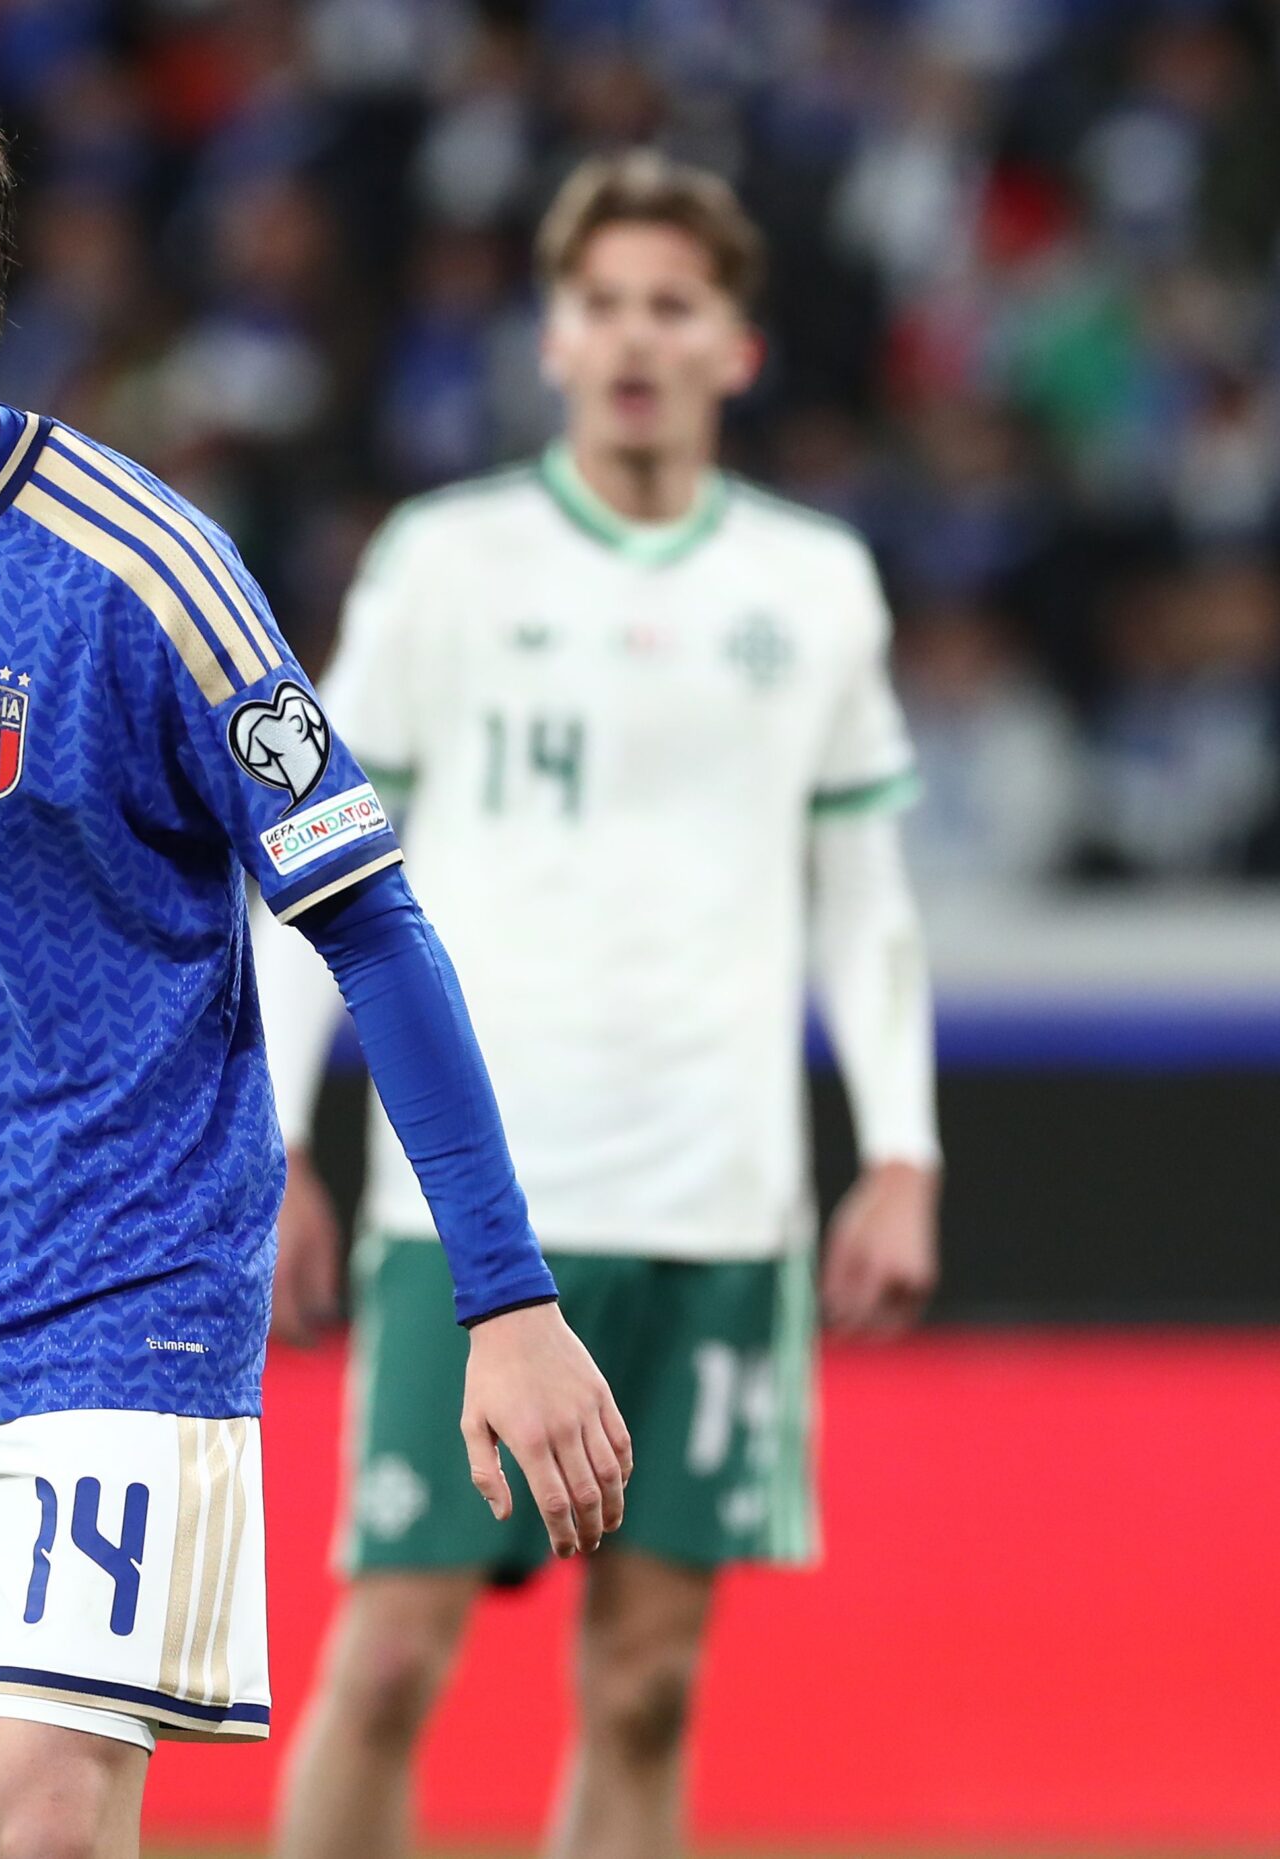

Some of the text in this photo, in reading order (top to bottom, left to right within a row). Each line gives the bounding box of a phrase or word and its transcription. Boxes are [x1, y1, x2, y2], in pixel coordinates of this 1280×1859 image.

[481, 707, 586, 828] 14
[266, 822, 295, 845] UEFA
[23, 1476, 150, 1637] 14
